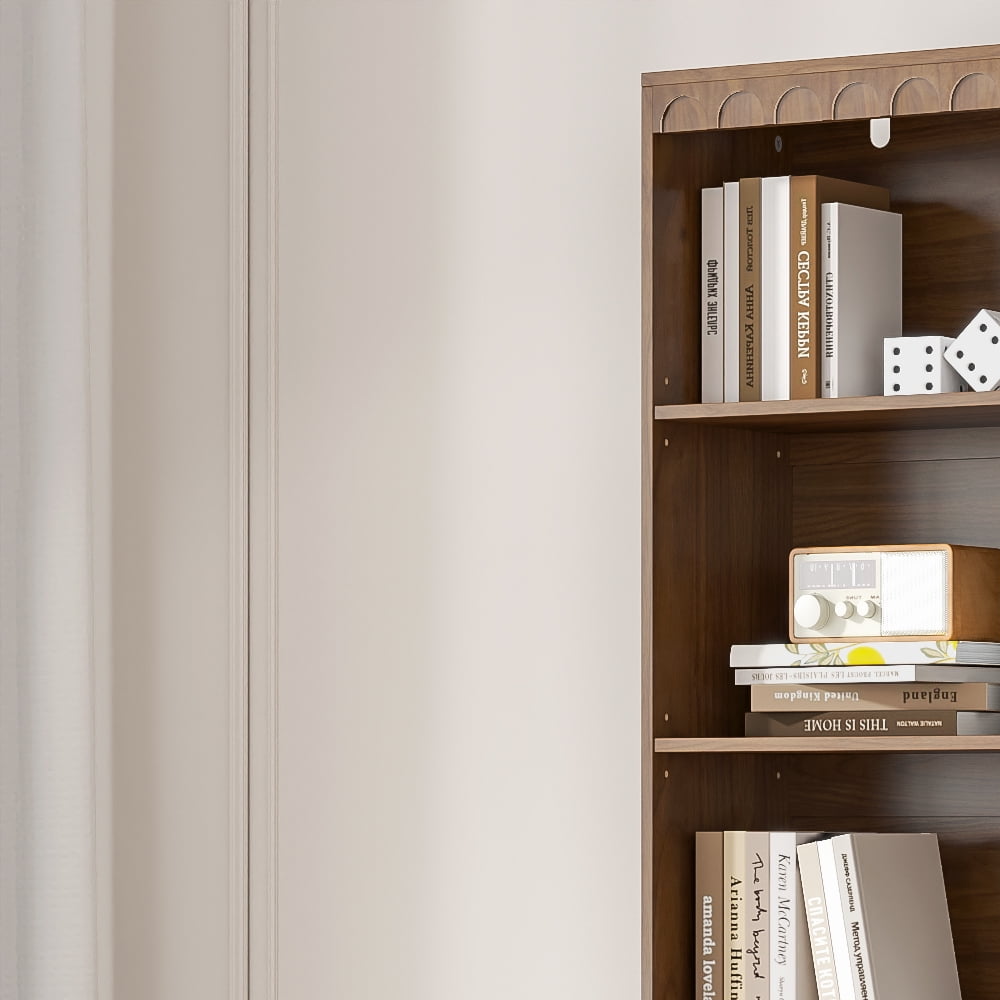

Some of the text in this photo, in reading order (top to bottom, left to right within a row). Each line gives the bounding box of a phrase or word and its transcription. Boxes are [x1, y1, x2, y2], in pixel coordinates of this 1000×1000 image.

[774, 690, 859, 702] United Kingdom
[902, 688, 957, 703] England
[803, 718, 889, 732] THIS IS HOME
[752, 852, 764, 885] The
[730, 875, 743, 941] Arianna
[773, 854, 791, 966] Karen McCartney
[702, 895, 716, 956] amanda
[807, 896, 832, 965] СПАСИТЕ
[851, 921, 862, 953] Метод
